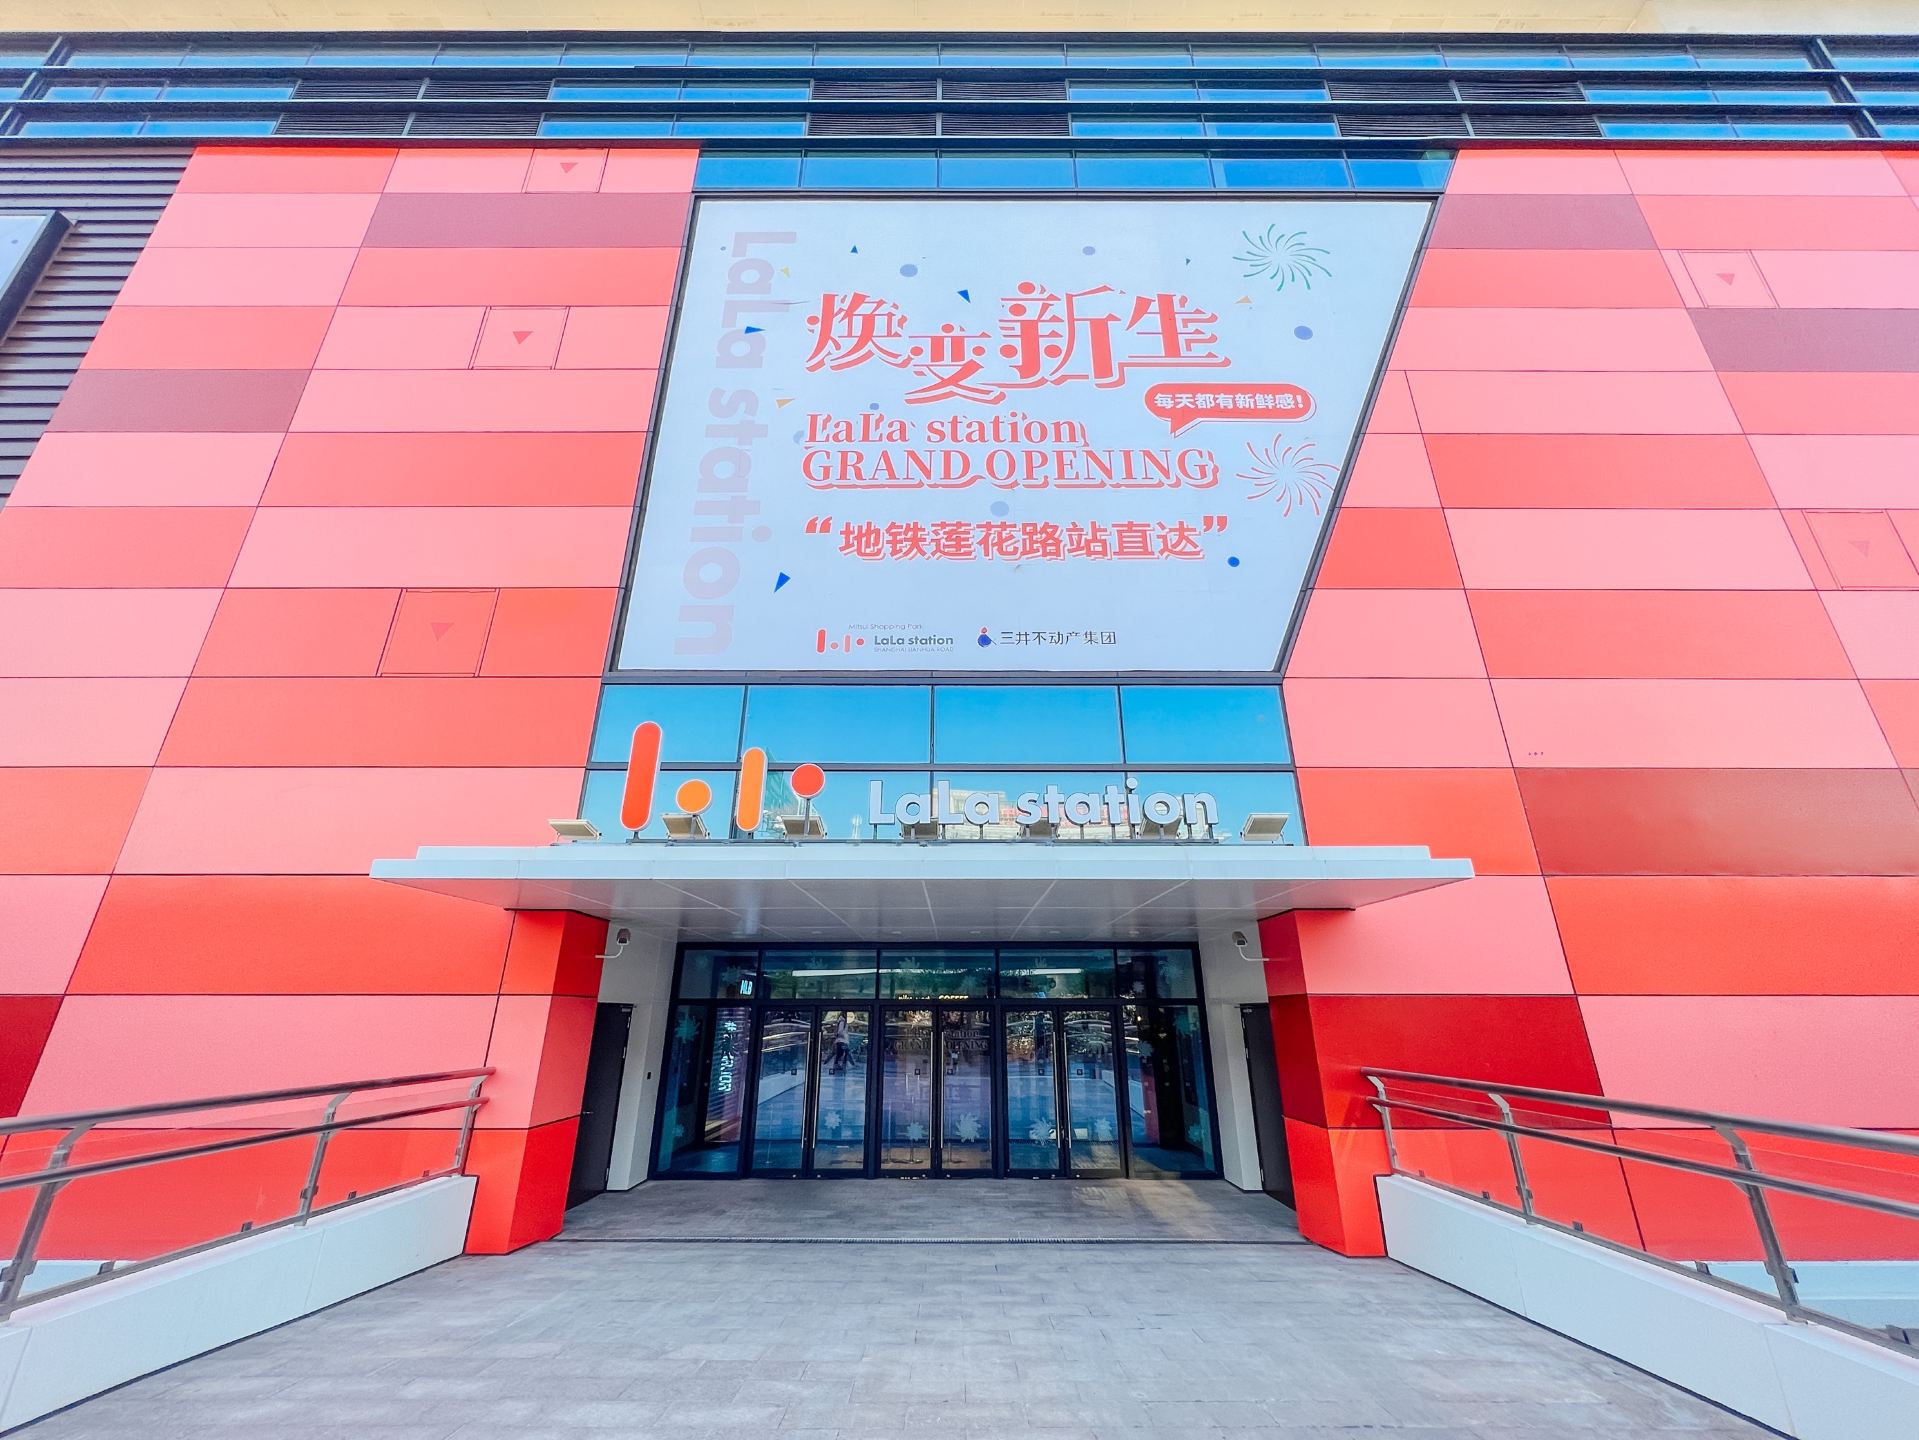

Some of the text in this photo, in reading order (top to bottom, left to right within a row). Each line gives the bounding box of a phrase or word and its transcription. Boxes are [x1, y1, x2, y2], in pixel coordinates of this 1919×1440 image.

[806, 281, 1231, 405] 焕变新生
[1154, 392, 1304, 409] 每天都有新鲜感!
[674, 231, 797, 656] LaLa station
[806, 411, 1086, 445] LaLa station
[802, 449, 1219, 488] GRAND OPENING
[874, 634, 954, 646] LaLa station
[1000, 630, 1117, 645] 三井不动产集团
[869, 777, 1219, 826] LaLa station
